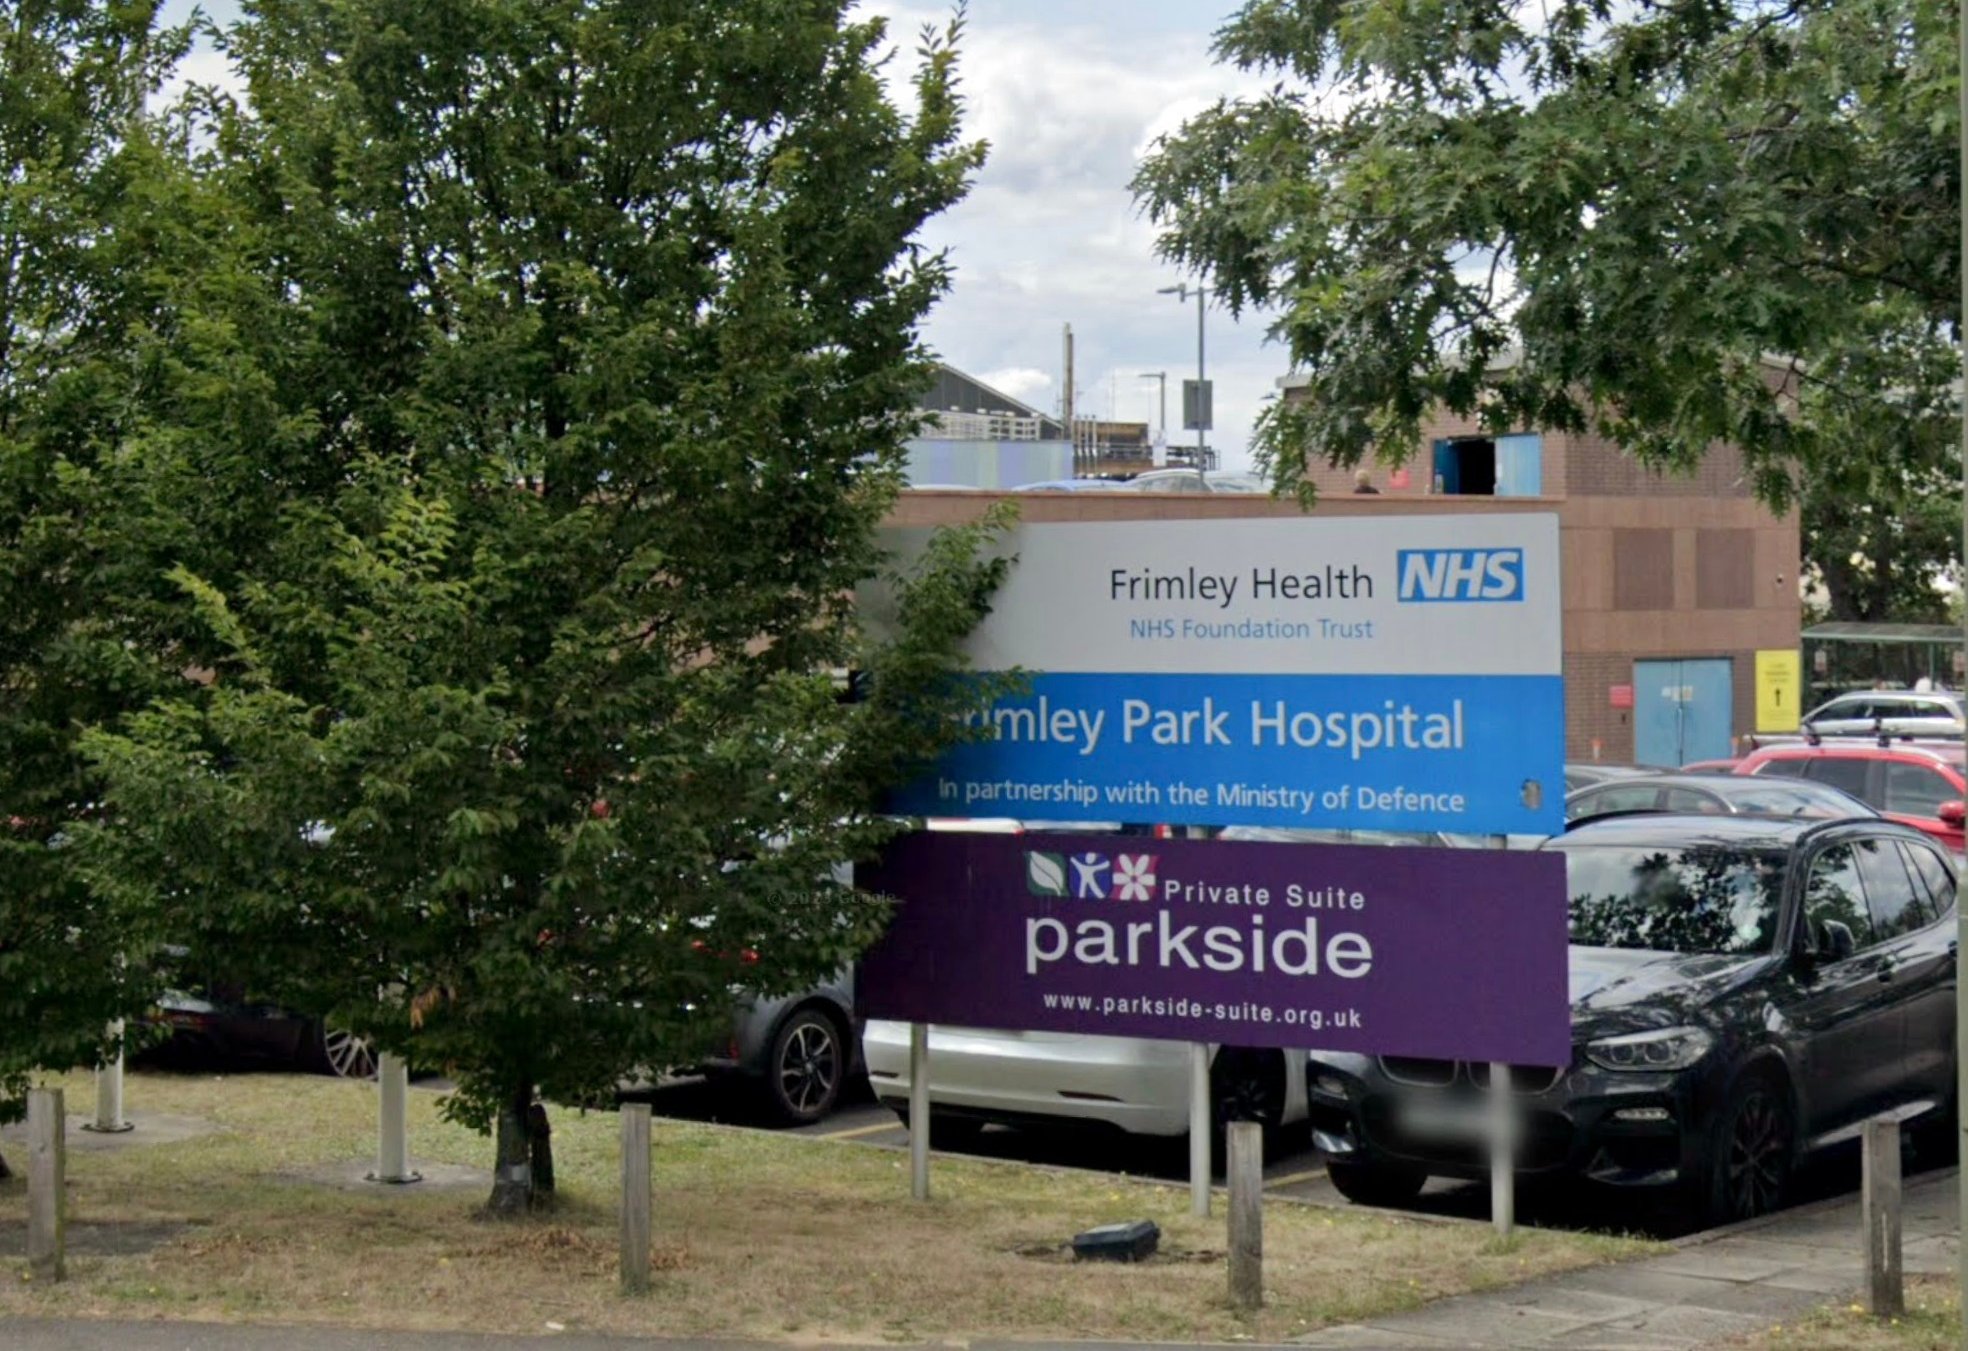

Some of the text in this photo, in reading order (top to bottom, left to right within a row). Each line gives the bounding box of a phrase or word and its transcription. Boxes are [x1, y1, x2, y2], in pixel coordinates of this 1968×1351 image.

[1111, 564, 1373, 608] Frimley Health
[1399, 551, 1520, 599] NHS
[1130, 618, 1374, 640] NHS Foundation Trust
[942, 695, 1463, 760] rimley Park Hospital
[938, 777, 1465, 814] In partnership with the Ministry of Defence
[1164, 880, 1365, 910] Private Suite
[1026, 910, 1374, 979] parkside
[1043, 992, 1362, 1030] www.parkside-suite.org.uk
